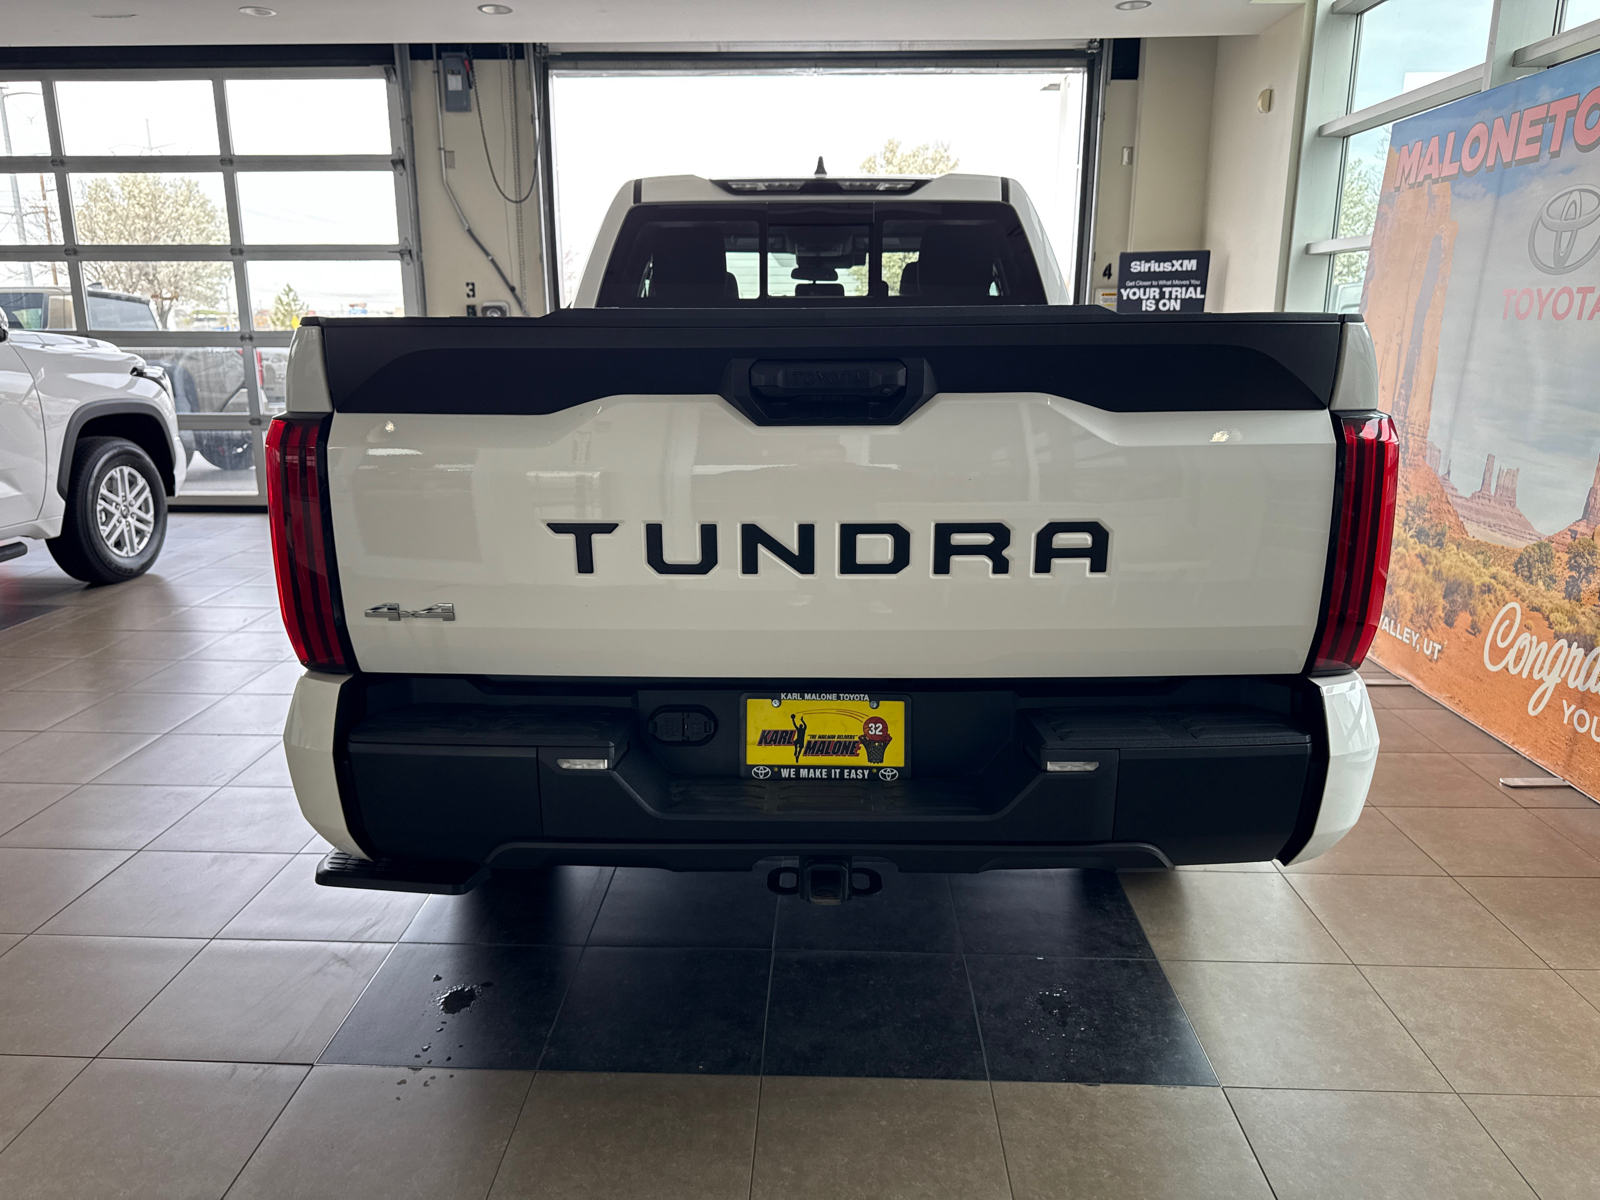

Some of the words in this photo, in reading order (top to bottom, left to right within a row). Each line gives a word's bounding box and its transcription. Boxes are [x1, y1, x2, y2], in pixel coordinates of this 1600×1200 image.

[1102, 263, 1112, 280] 4
[1130, 259, 1197, 273] SiriusXM
[466, 282, 476, 298] 3
[1120, 288, 1160, 300] YOUR
[1162, 287, 1205, 299] TRIAL
[1142, 300, 1156, 312] IS
[1158, 300, 1181, 312] ON
[792, 371, 863, 386] TOYOTA
[545, 521, 1110, 575] TUNDRA
[1423, 637, 1442, 660] UT
[781, 692, 802, 700] KARL
[804, 693, 837, 701] MALONE
[839, 694, 869, 702] TOYOTA
[868, 723, 883, 736] 32
[757, 729, 797, 746] KARL
[802, 740, 861, 757] MALONE
[781, 768, 796, 778] WE
[800, 768, 828, 779] MAKE
[831, 769, 840, 779] IT
[844, 769, 869, 779] EASY
